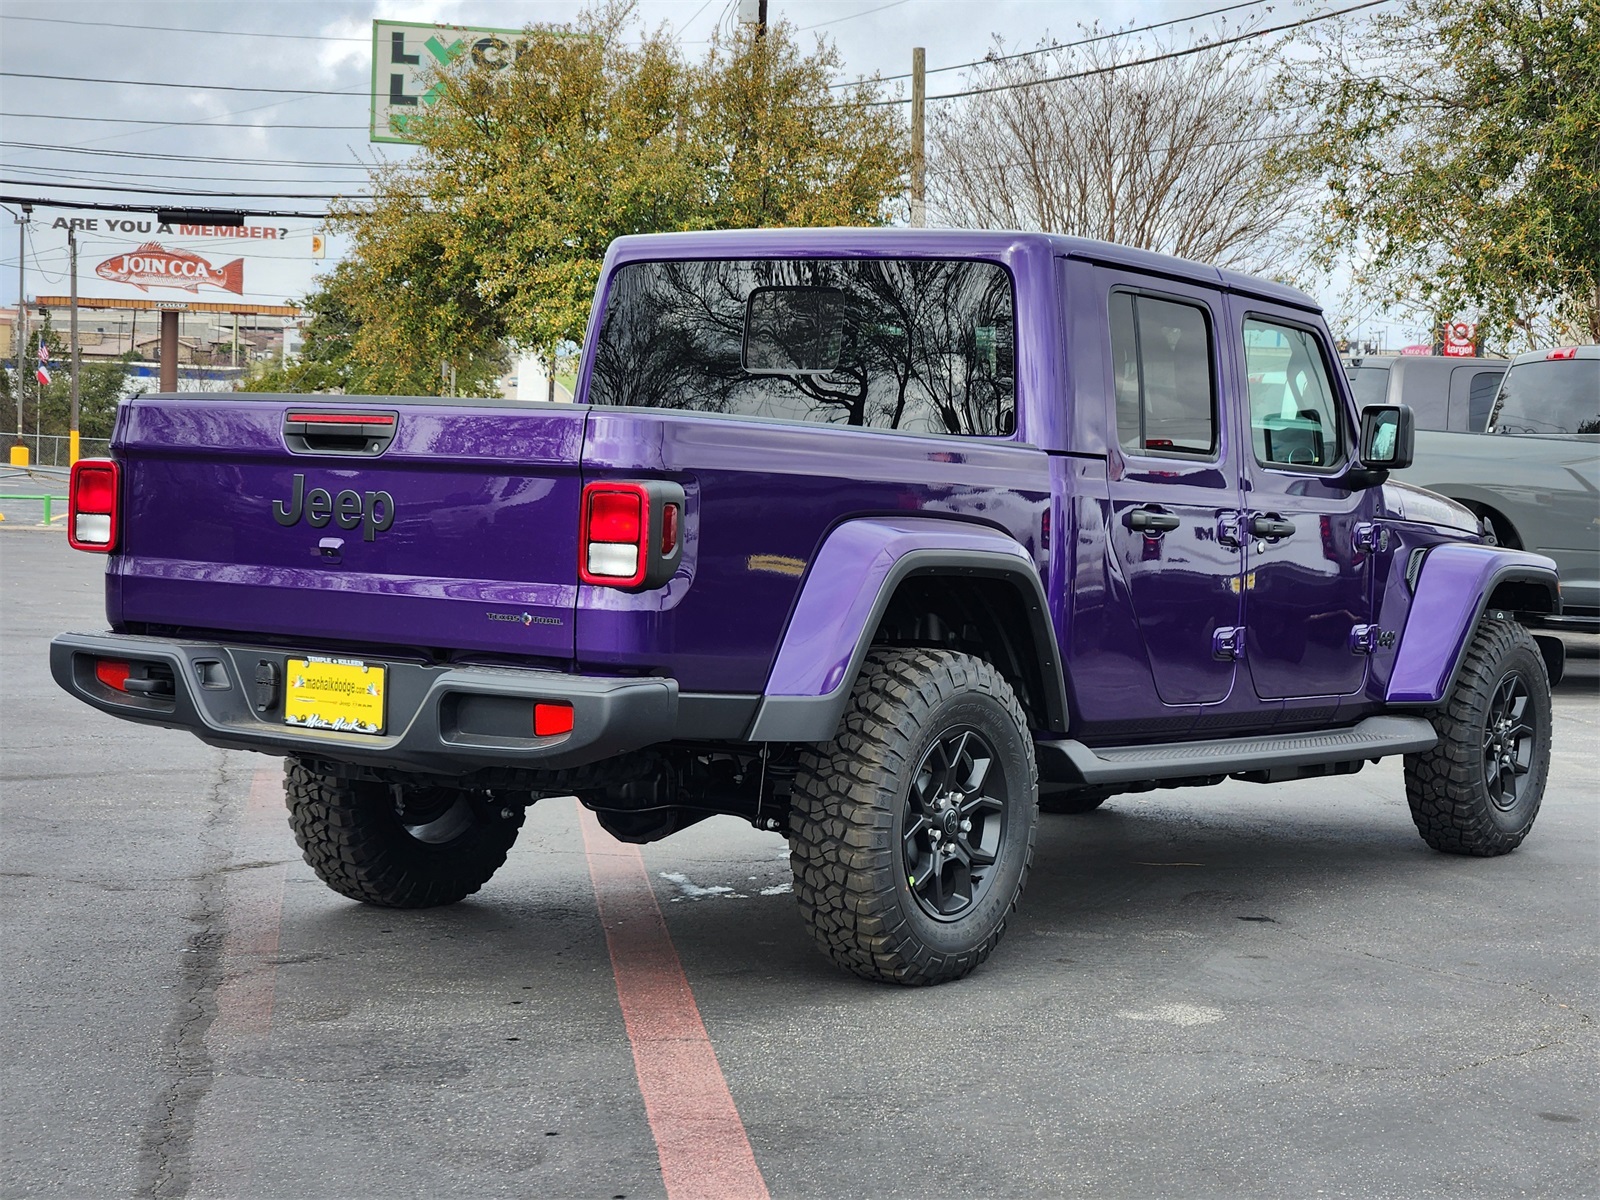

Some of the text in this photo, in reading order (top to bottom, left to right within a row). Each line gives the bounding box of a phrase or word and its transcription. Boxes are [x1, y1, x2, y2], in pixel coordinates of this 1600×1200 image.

[52, 217, 289, 240] ARE YOU A MEMBER?
[118, 255, 209, 278] JOIN CCA
[1446, 344, 1474, 355] target
[272, 473, 395, 542] Jeep
[485, 612, 564, 626] TEXAS TRAIL
[307, 656, 364, 667] TEMPLE KILLEEN
[305, 677, 366, 696] machaikdodge.com
[305, 714, 361, 731] Mac Haik
